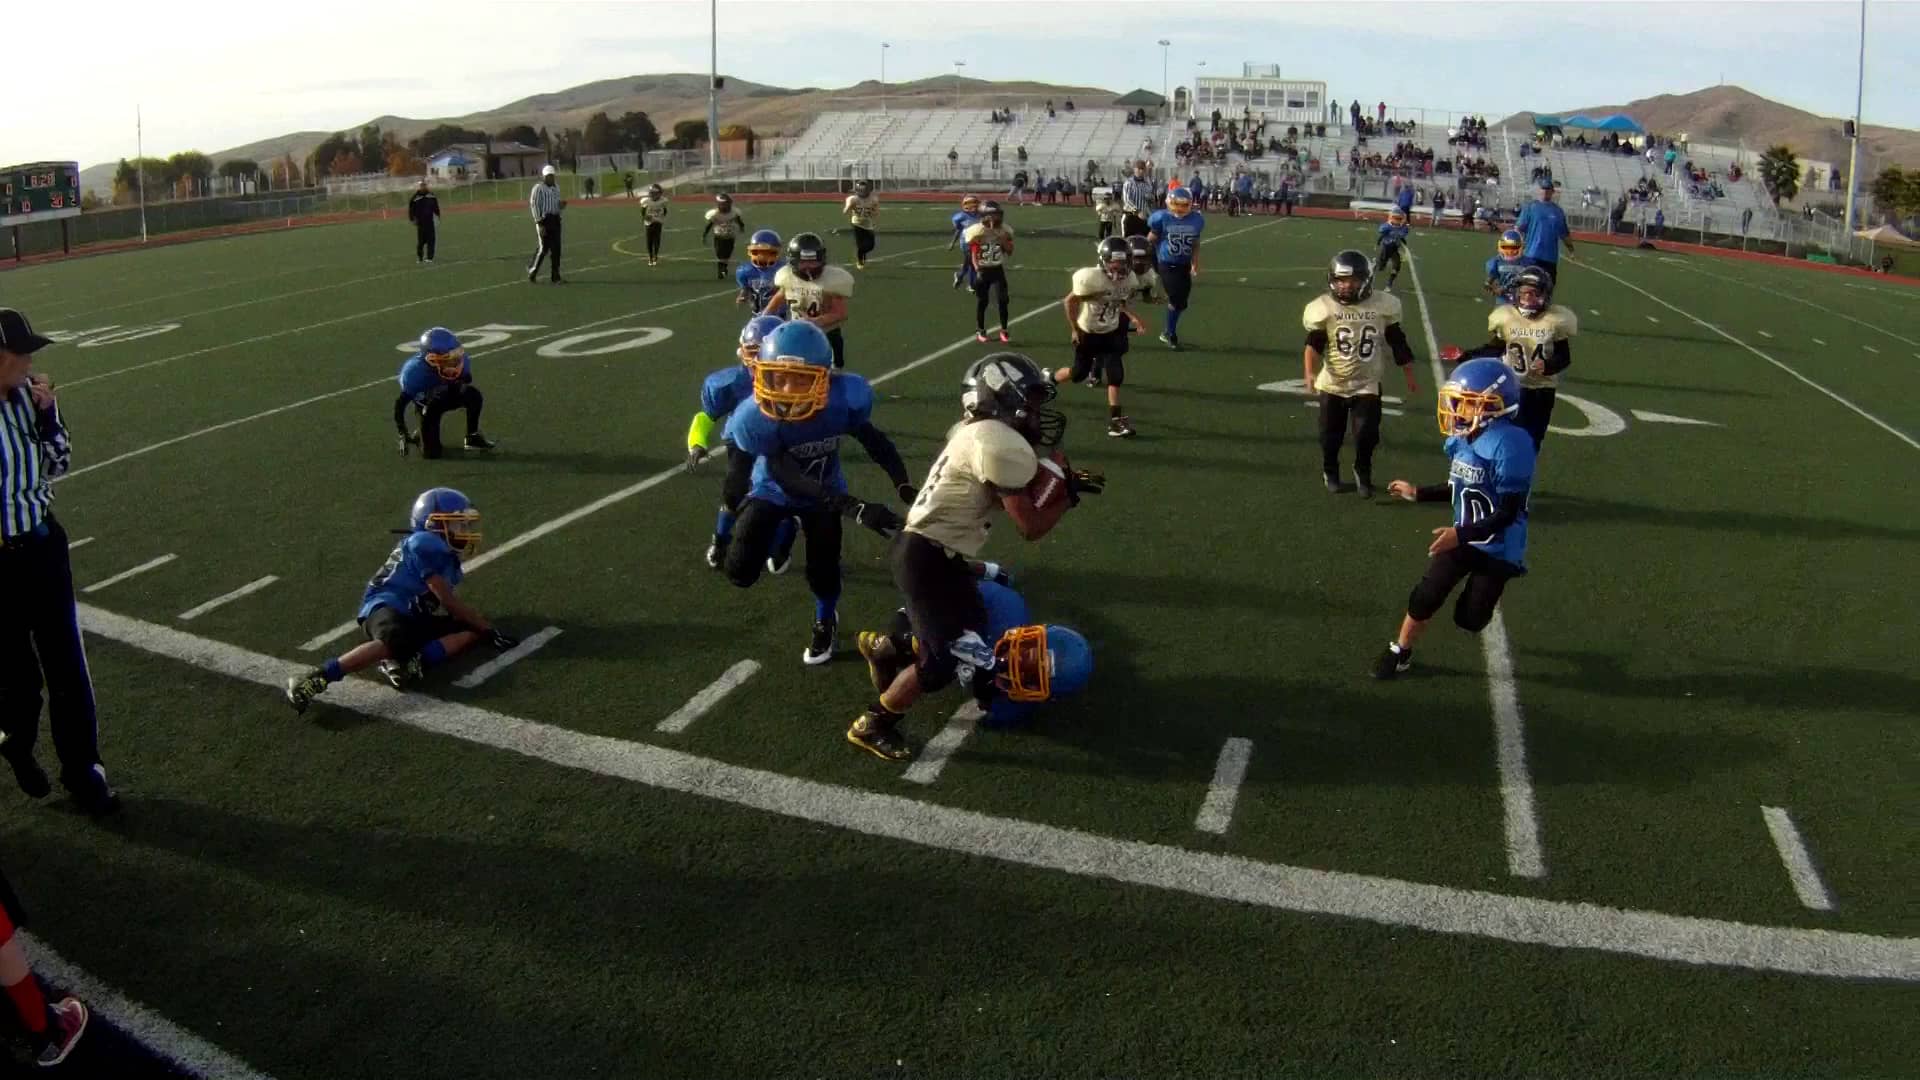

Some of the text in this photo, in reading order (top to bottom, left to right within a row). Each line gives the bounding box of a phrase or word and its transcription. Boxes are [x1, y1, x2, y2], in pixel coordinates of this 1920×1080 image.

[1167, 232, 1194, 256] 55
[1334, 311, 1377, 321] WOLVES
[1335, 324, 1378, 361] 66
[1507, 341, 1549, 374] 34
